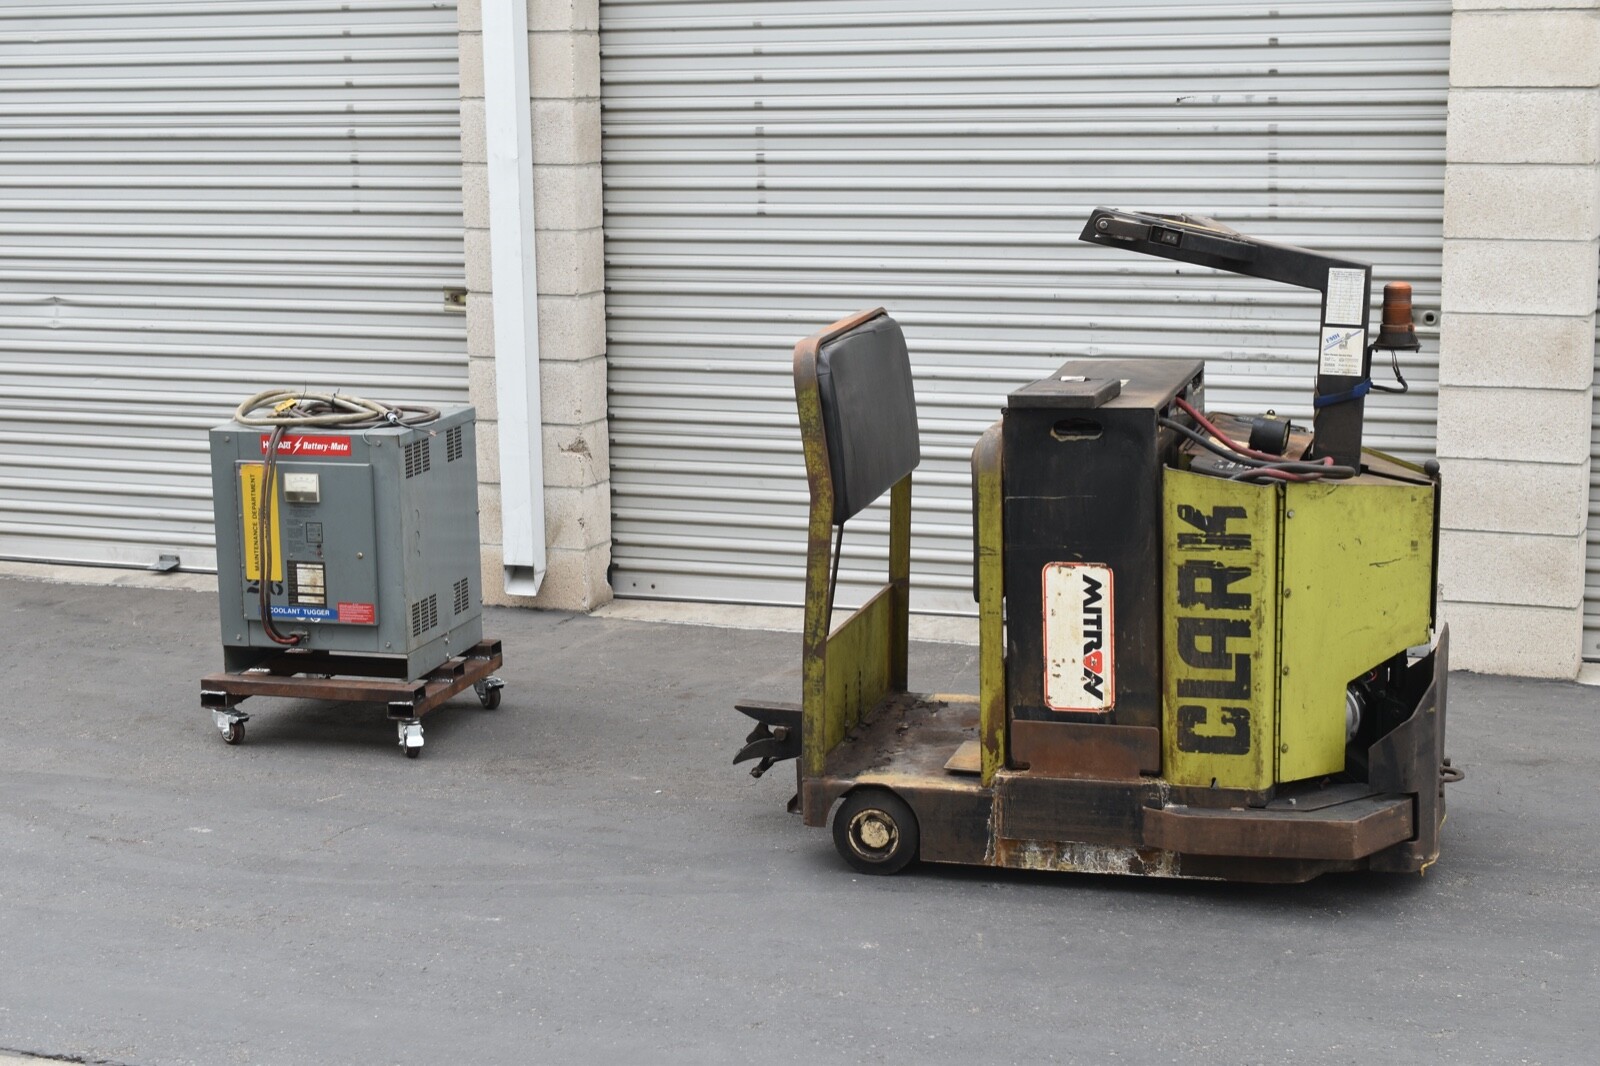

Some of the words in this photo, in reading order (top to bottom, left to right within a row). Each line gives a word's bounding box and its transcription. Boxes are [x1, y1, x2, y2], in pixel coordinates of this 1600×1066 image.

[262, 440, 292, 450] HART
[303, 441, 348, 452] Battery-Mate
[250, 474, 258, 519] DEPARTMENT
[252, 522, 260, 572] MAINTENANCE
[303, 608, 330, 616] TUGGER
[1176, 503, 1252, 755] CLARK
